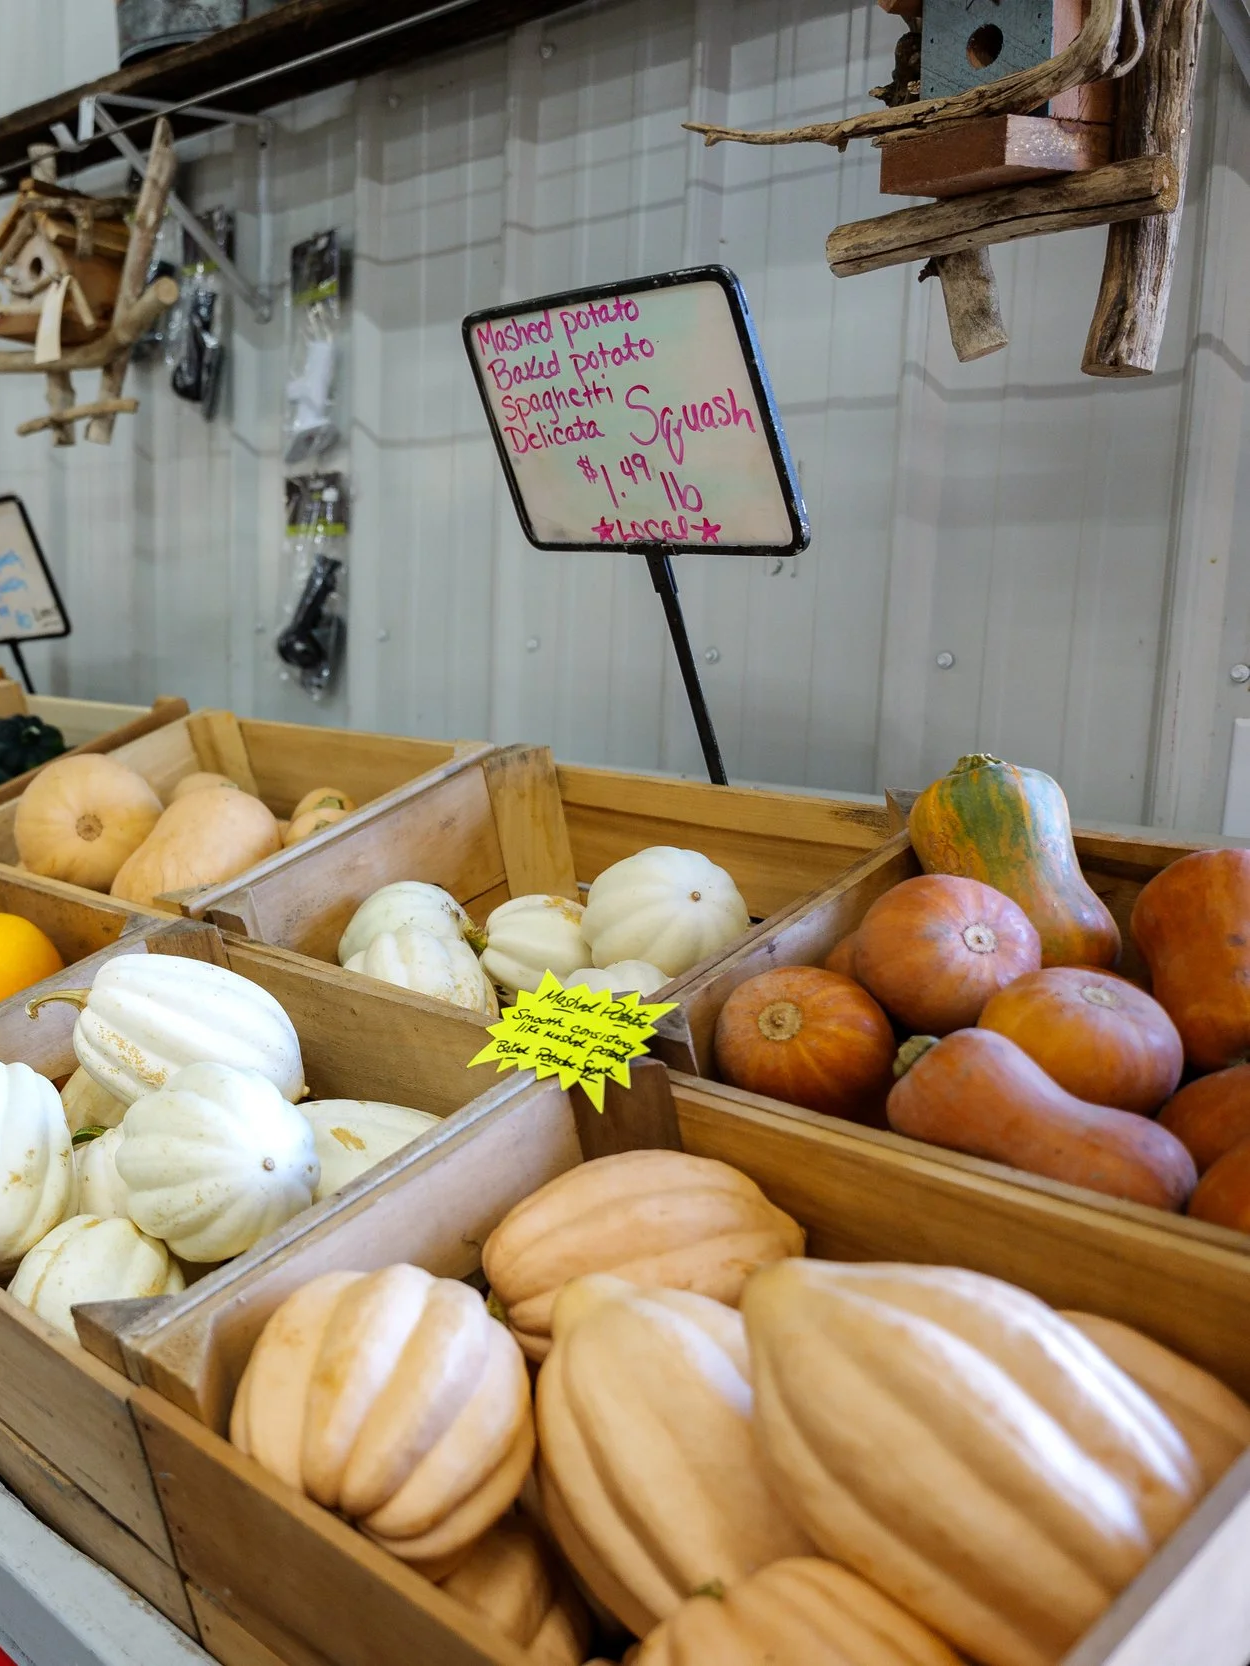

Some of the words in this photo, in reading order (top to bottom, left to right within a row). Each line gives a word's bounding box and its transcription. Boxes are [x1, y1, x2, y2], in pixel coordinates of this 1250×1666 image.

[477, 309, 553, 355] Mashed
[559, 296, 639, 349] potato
[487, 350, 561, 391] Baked
[569, 332, 655, 386] potato
[502, 373, 613, 430] Spaghetti
[625, 384, 756, 466] Squash
[504, 416, 605, 453] Delicata
[577, 453, 652, 508] $1.49
[660, 471, 703, 512] lb
